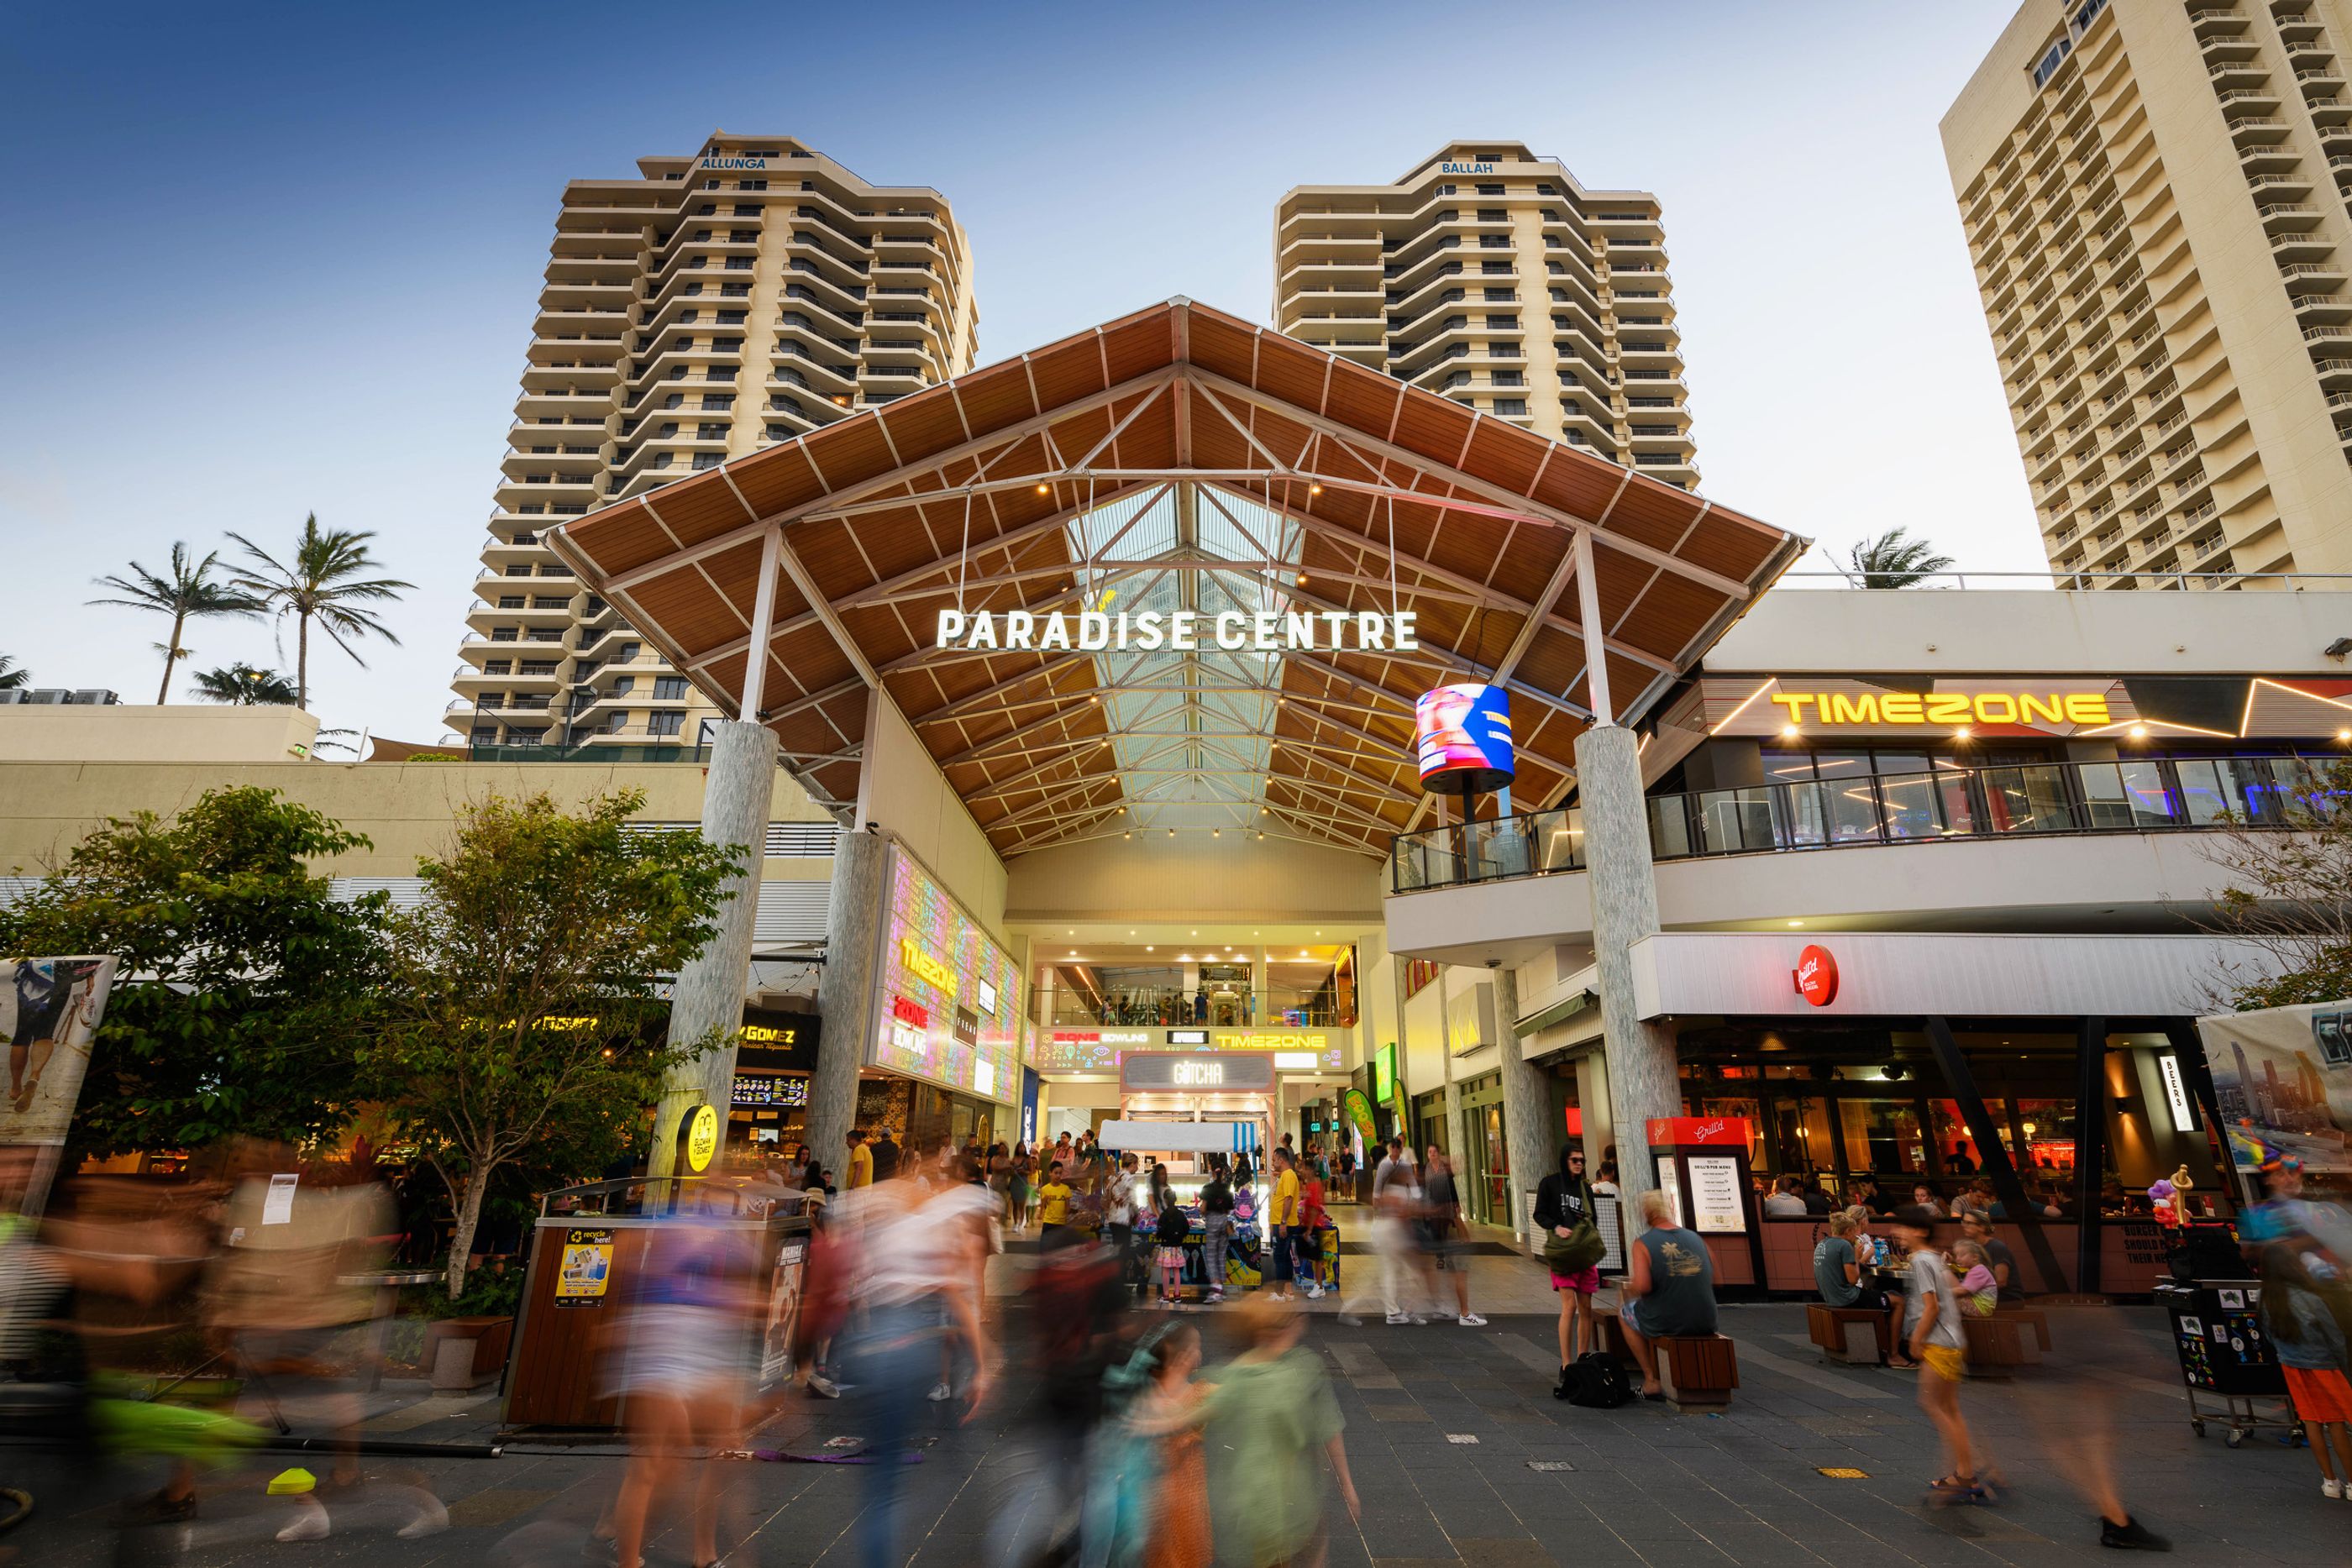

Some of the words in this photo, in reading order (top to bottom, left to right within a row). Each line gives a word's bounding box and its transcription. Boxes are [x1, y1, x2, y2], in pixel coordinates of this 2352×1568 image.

[701, 159, 765, 169] ALLUNGA
[1442, 163, 1493, 173] BALLAH
[937, 611, 1195, 652] PARADISE
[1216, 611, 1420, 653] CENTRE
[1772, 693, 2111, 724] TIMEZONE
[900, 938, 958, 998] TIMEZONE
[894, 995, 928, 1030] ZONE
[747, 1025, 795, 1043] GOMEZ
[1053, 1033, 1100, 1042] ZONE
[1101, 1033, 1149, 1042] BOWLING
[1216, 1035, 1326, 1047] TIMEZONE
[2166, 1061, 2182, 1107] BEERS
[1693, 1120, 1725, 1142] Grill'd
[584, 1230, 606, 1239] recycle
[2124, 1240, 2158, 1250] SHOULD
[2127, 1253, 2153, 1263] THEIR
